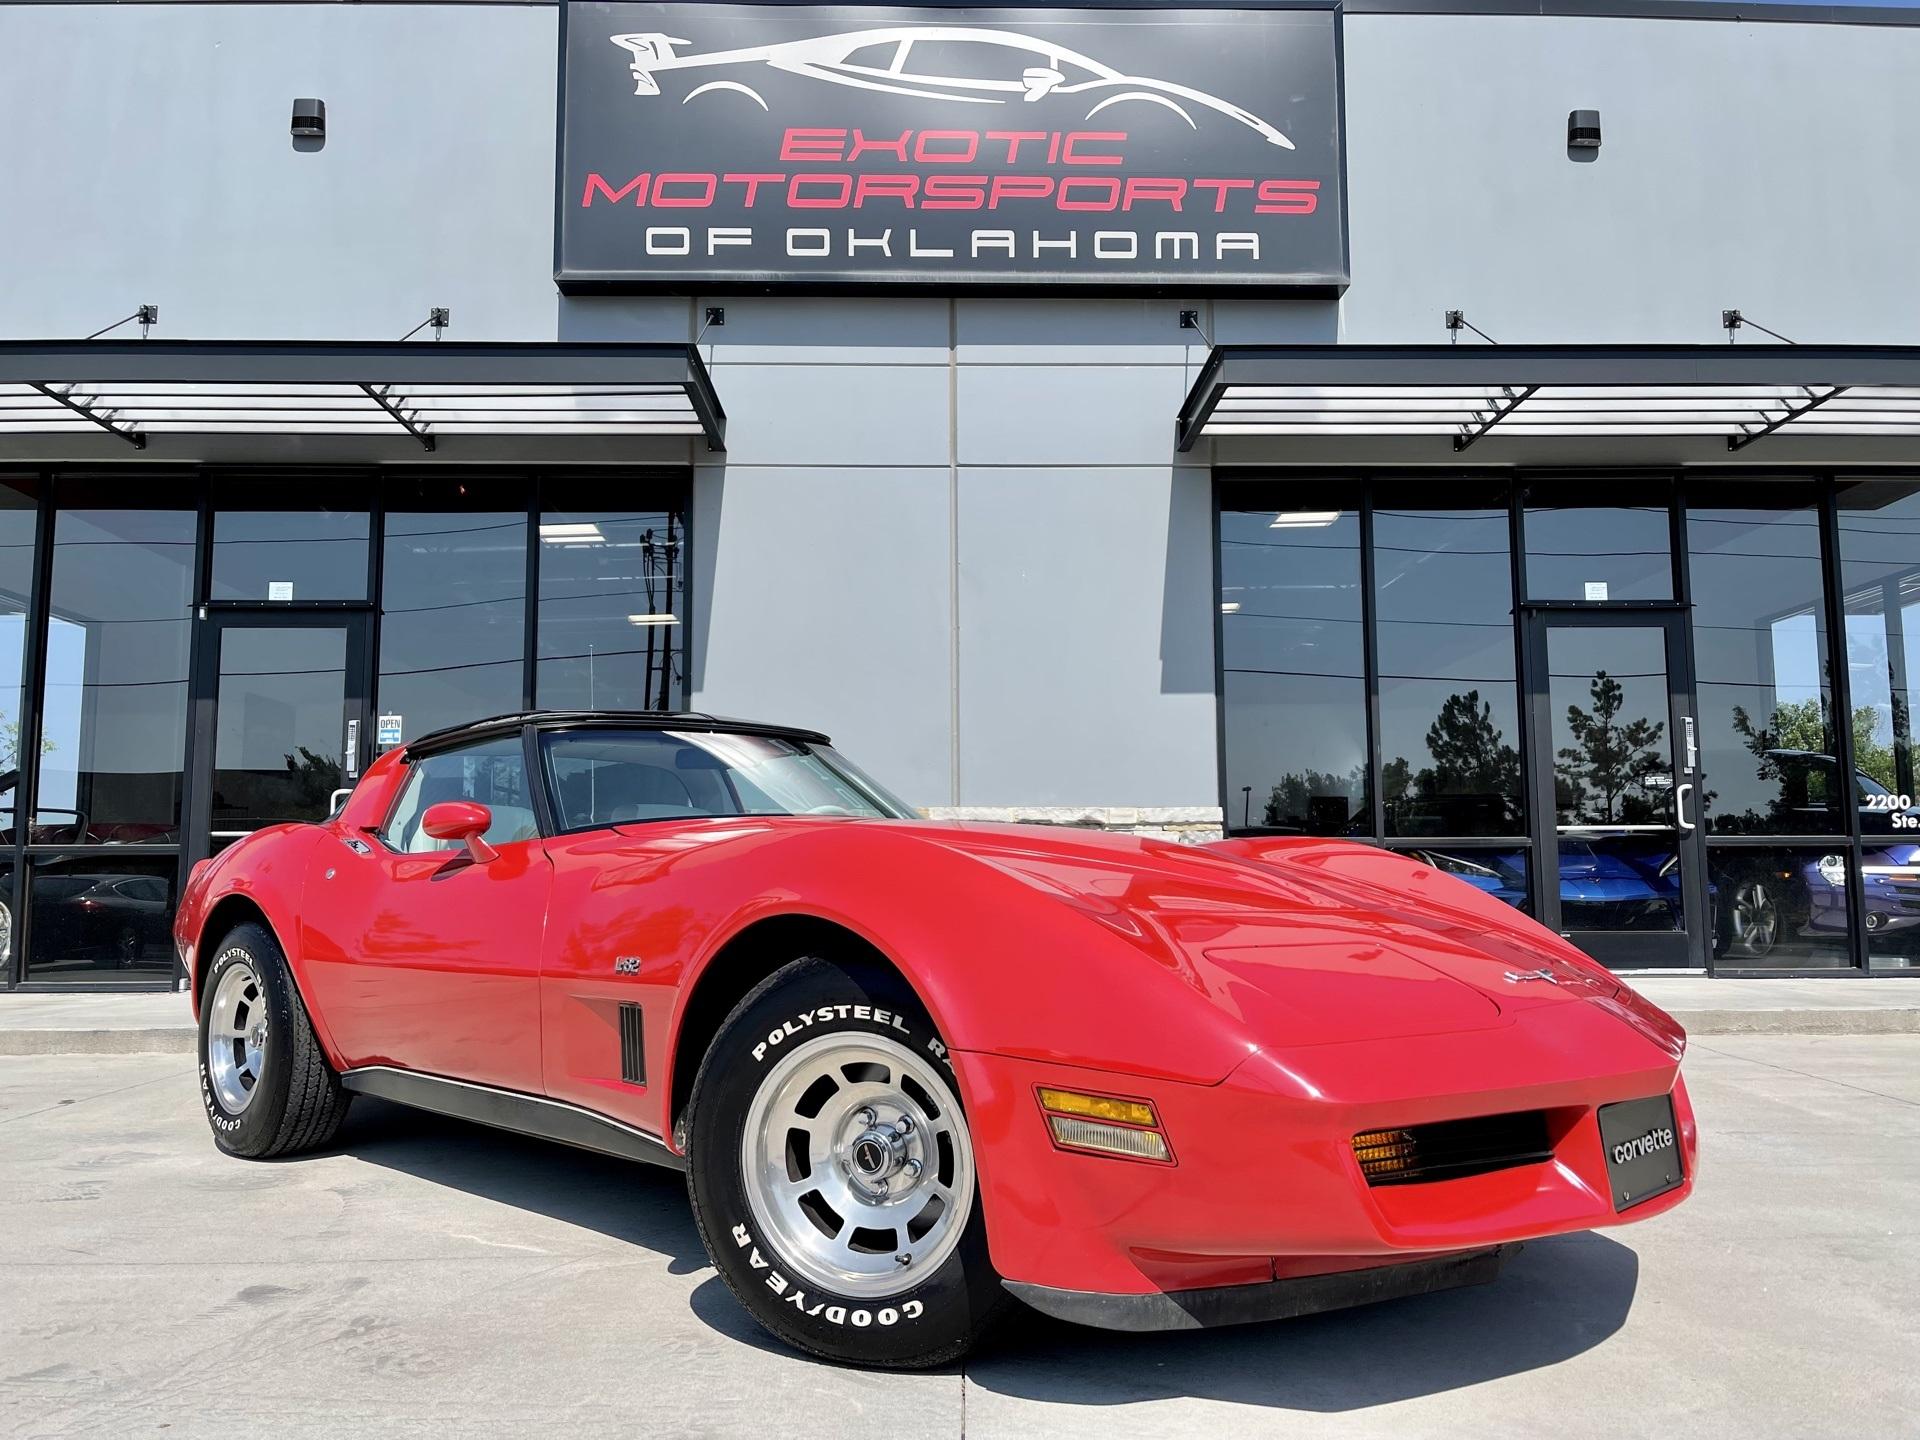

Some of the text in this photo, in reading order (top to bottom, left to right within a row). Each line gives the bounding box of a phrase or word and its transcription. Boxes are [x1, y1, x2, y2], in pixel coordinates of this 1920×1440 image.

[780, 128, 1127, 164] EXOTIC
[581, 173, 1320, 214] MOTORSPORTS
[645, 227, 1260, 259] OF OKLAHOMA
[380, 719, 401, 729] OPEN
[1866, 794, 1911, 810] 2200
[213, 947, 254, 974] POLYSTEEL
[751, 1004, 910, 1062] POLYSTEEL
[200, 1063, 241, 1131] GOODYEAR
[1613, 1128, 1673, 1165] corvette
[731, 1222, 924, 1327] GOODYEAR
